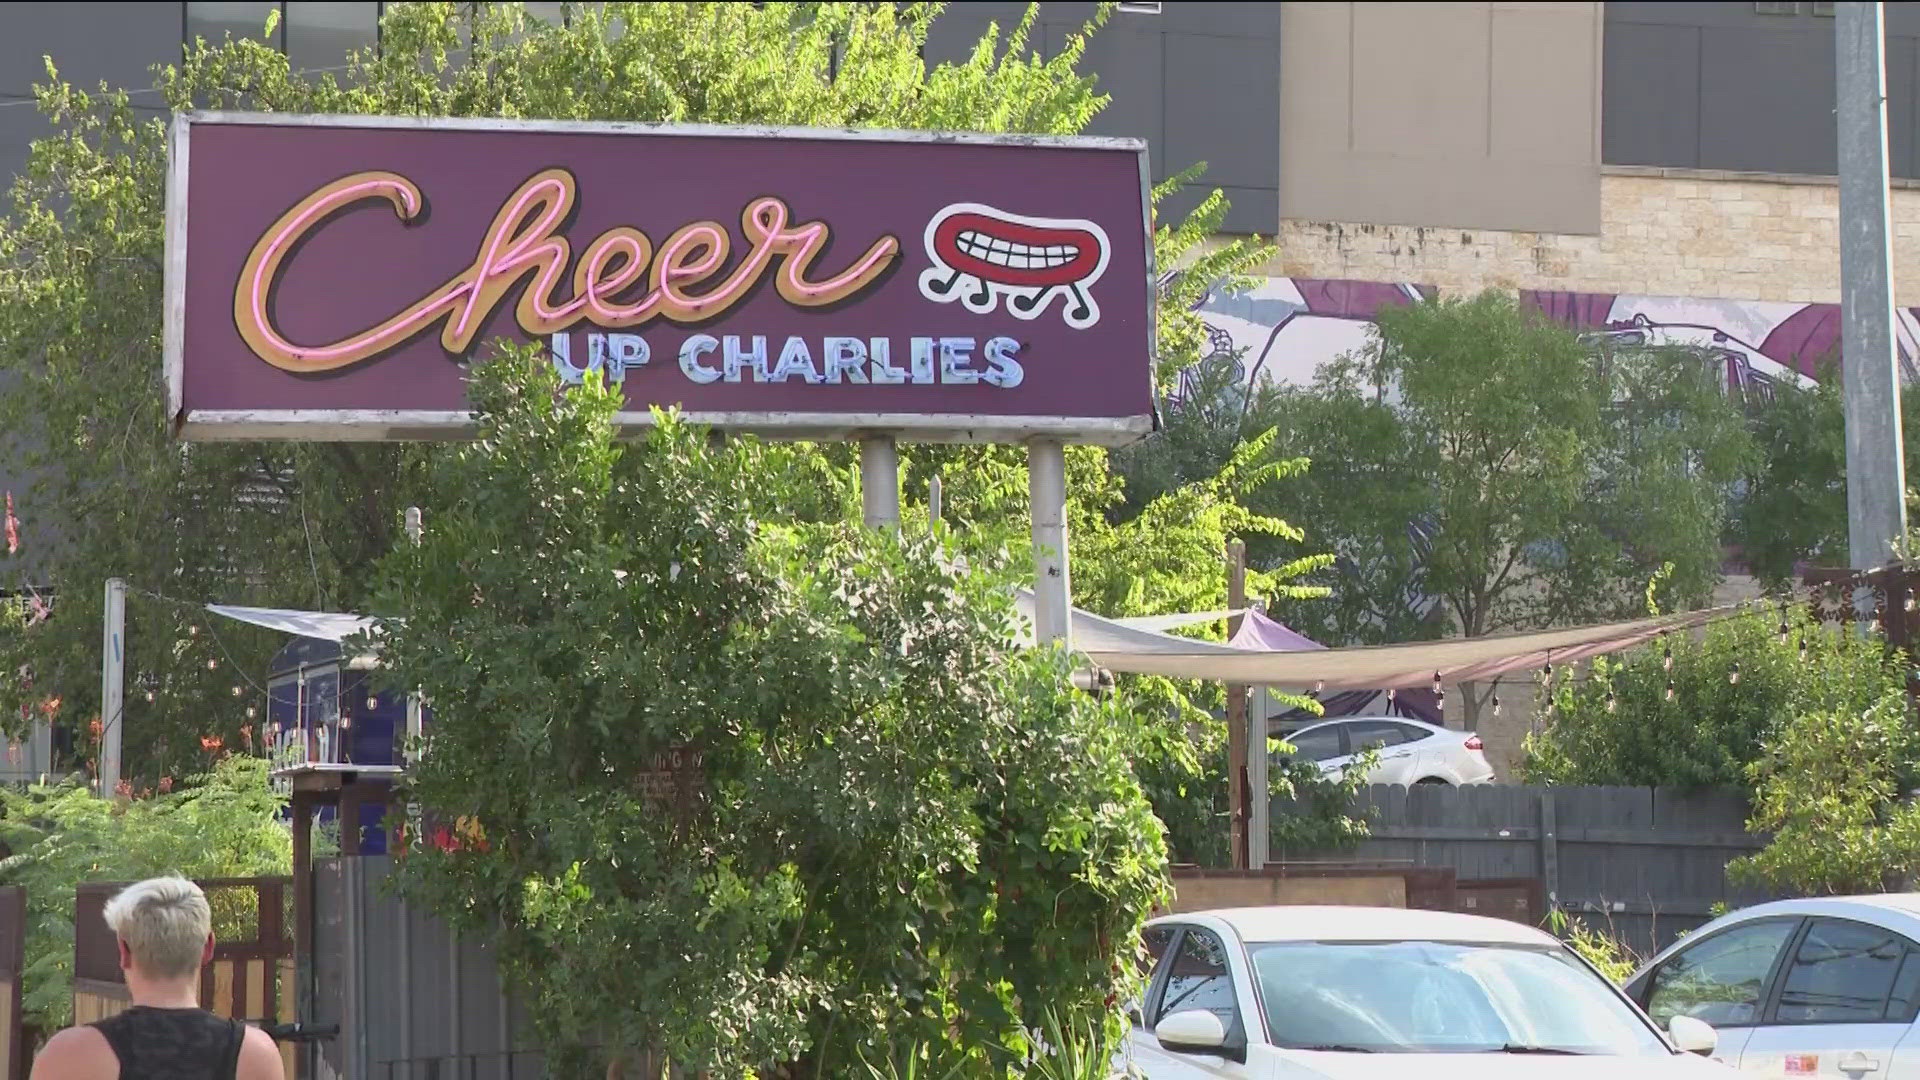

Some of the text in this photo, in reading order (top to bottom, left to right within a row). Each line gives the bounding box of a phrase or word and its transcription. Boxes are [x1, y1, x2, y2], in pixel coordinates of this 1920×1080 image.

[233, 168, 899, 373] Cheer
[552, 333, 1024, 388] UP CHARLIES
